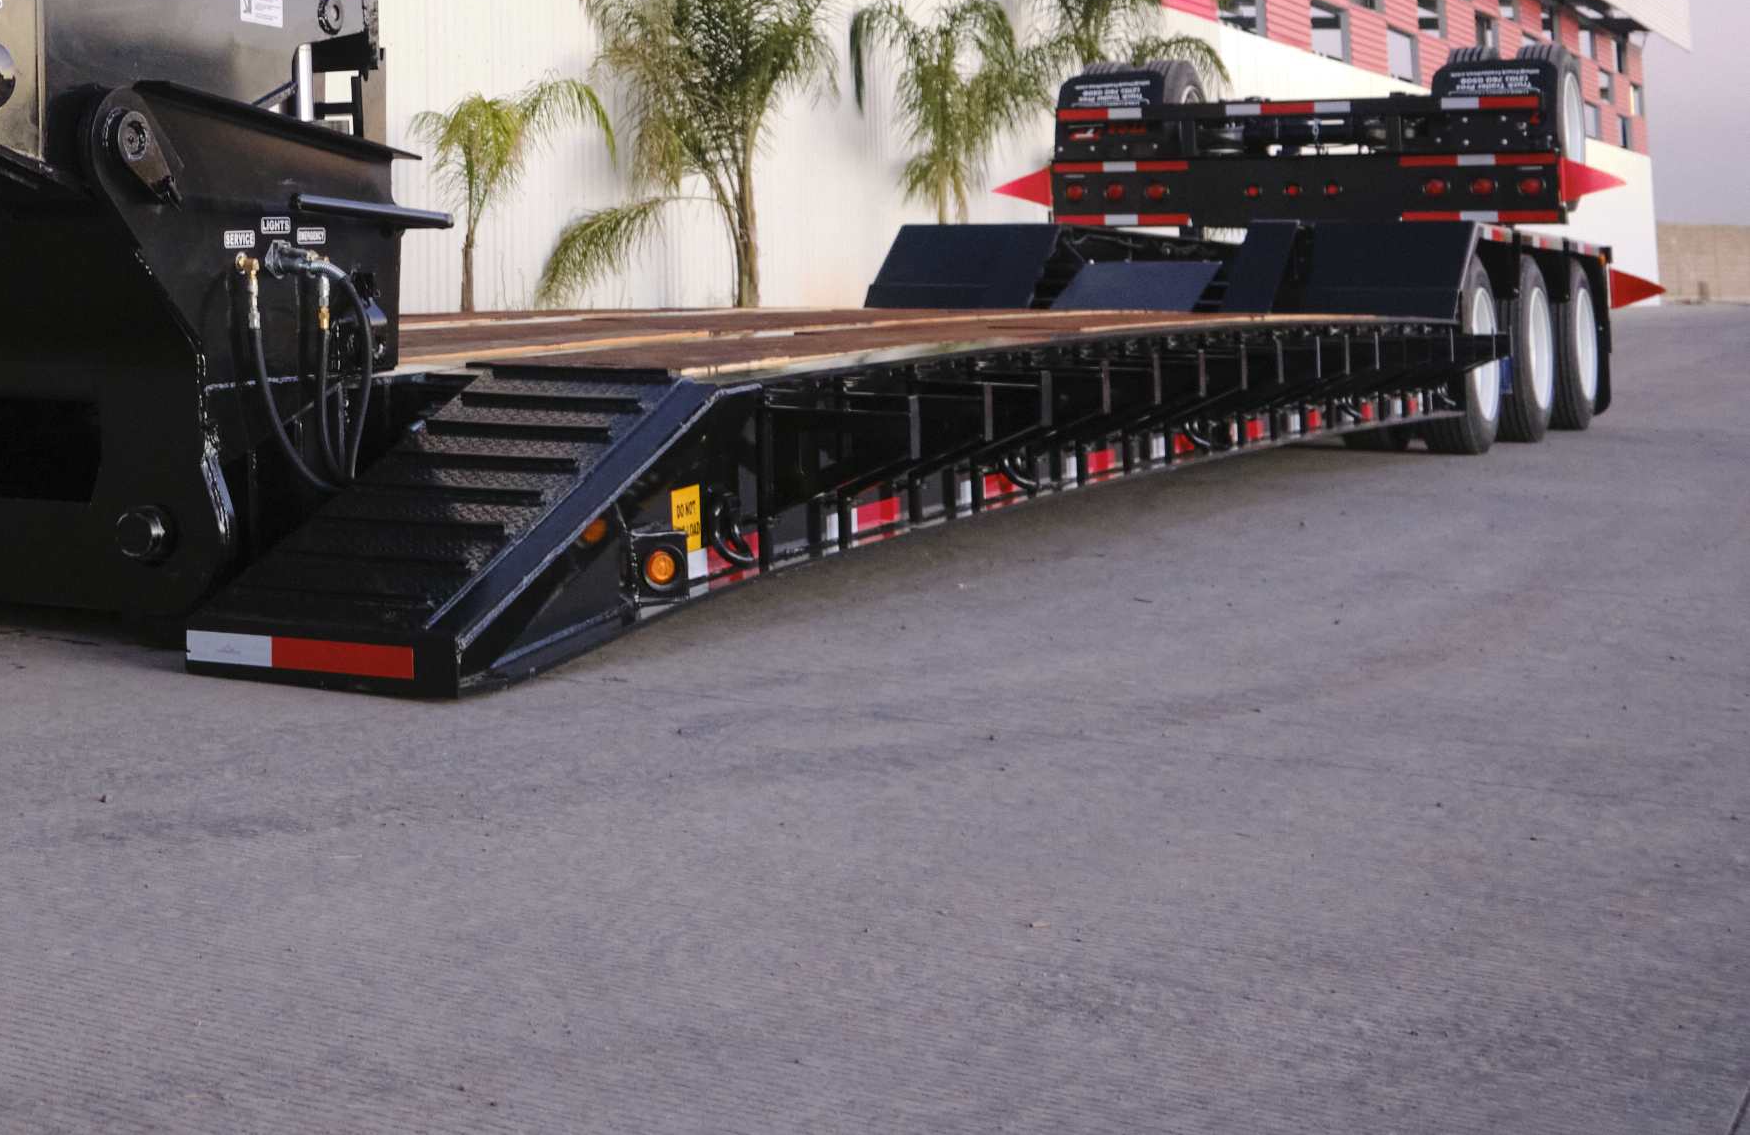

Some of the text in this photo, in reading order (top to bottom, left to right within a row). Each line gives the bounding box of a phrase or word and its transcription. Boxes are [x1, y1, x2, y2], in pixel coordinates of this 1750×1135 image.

[1507, 80, 1532, 88] Truck
[262, 220, 290, 231] LIGHTS
[225, 233, 254, 246] SERVICE
[298, 232, 324, 242] EMERGENCY
[677, 500, 696, 519] DO NOT
